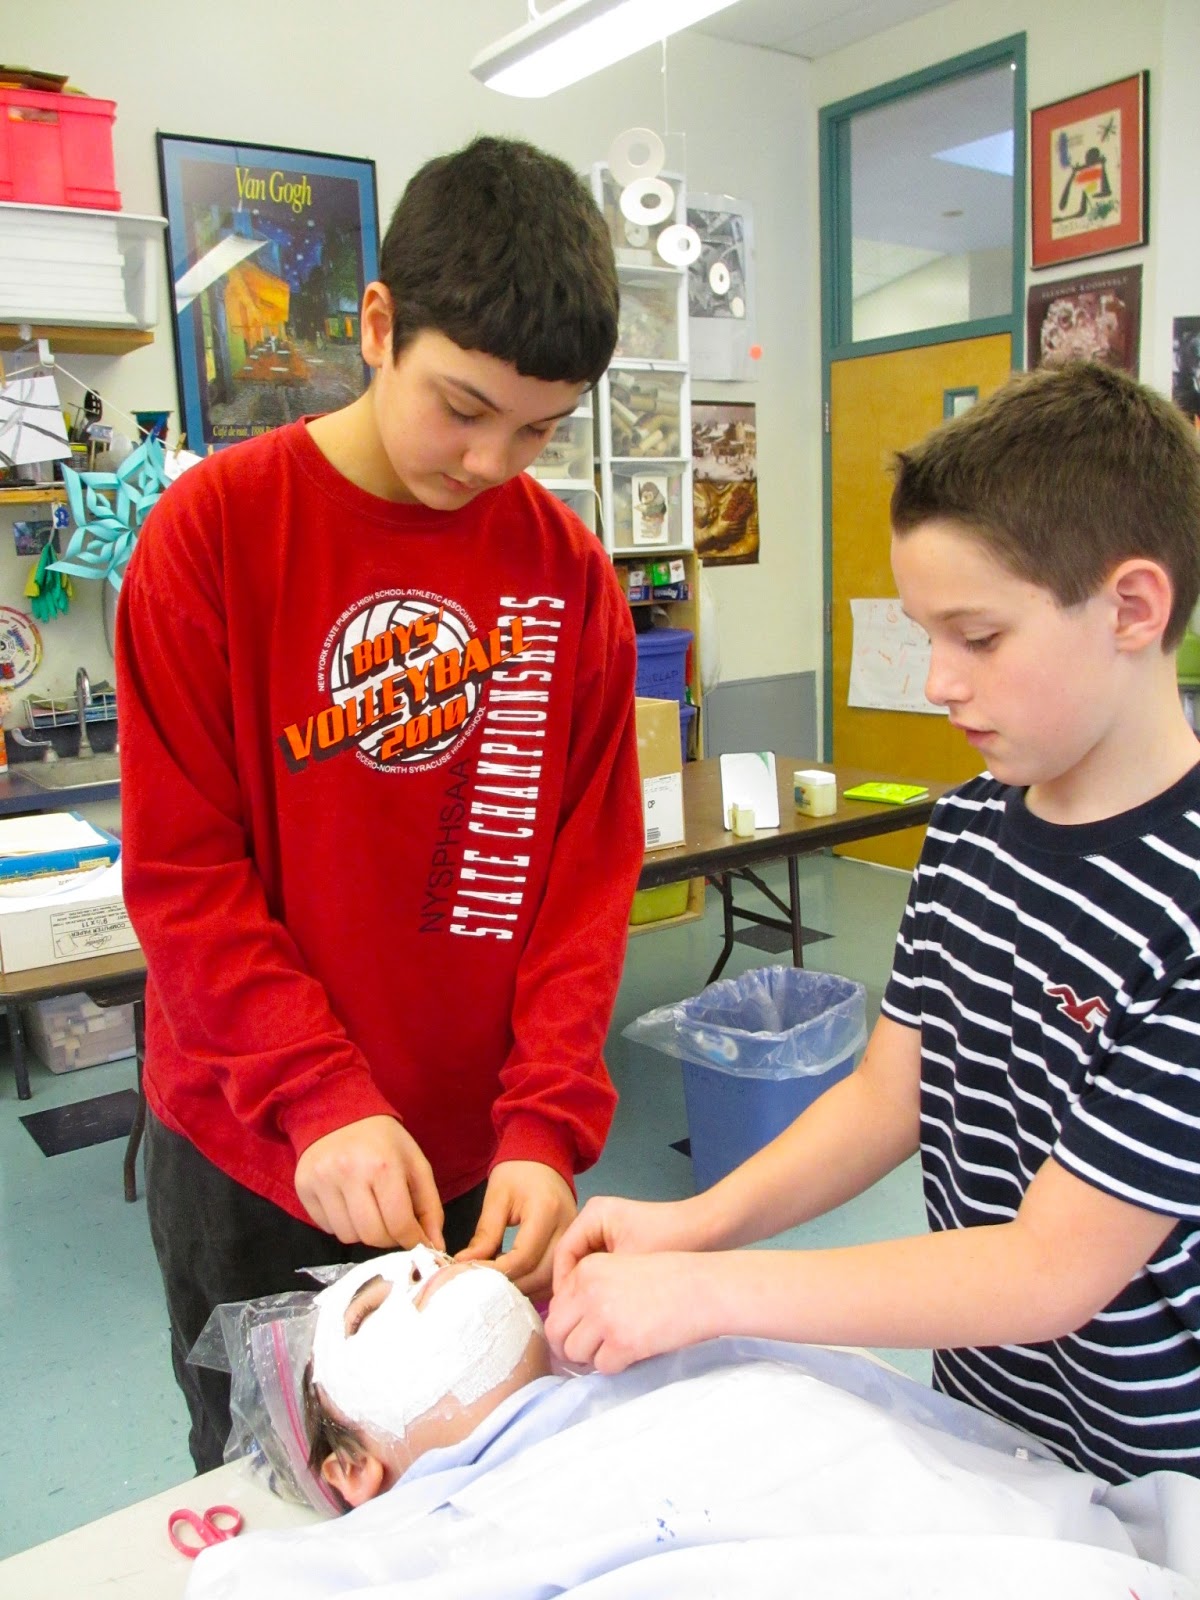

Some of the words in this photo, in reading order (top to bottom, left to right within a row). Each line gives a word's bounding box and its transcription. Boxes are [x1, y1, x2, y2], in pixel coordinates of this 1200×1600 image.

[235, 167, 266, 201] Van
[269, 171, 312, 213] Gogh
[356, 595, 375, 608] HIGH
[374, 588, 405, 600] SCHOOL
[406, 588, 443, 602] ATHLETIC
[335, 603, 358, 627] PUBLIC
[323, 624, 340, 649] STATE
[318, 649, 328, 672] YORK
[283, 616, 533, 761] VOLLEYBALL
[317, 673, 325, 692] NEW
[355, 750, 408, 774] CICERO-NORTH
[408, 753, 452, 774] SYRACUSE
[451, 737, 467, 755] HIGH
[464, 705, 487, 738] SCHOOL
[380, 695, 467, 761] 2010
[418, 758, 472, 934] NYSPHSAA
[449, 849, 530, 940] STATE
[92, 922, 126, 935] COMPUTER
